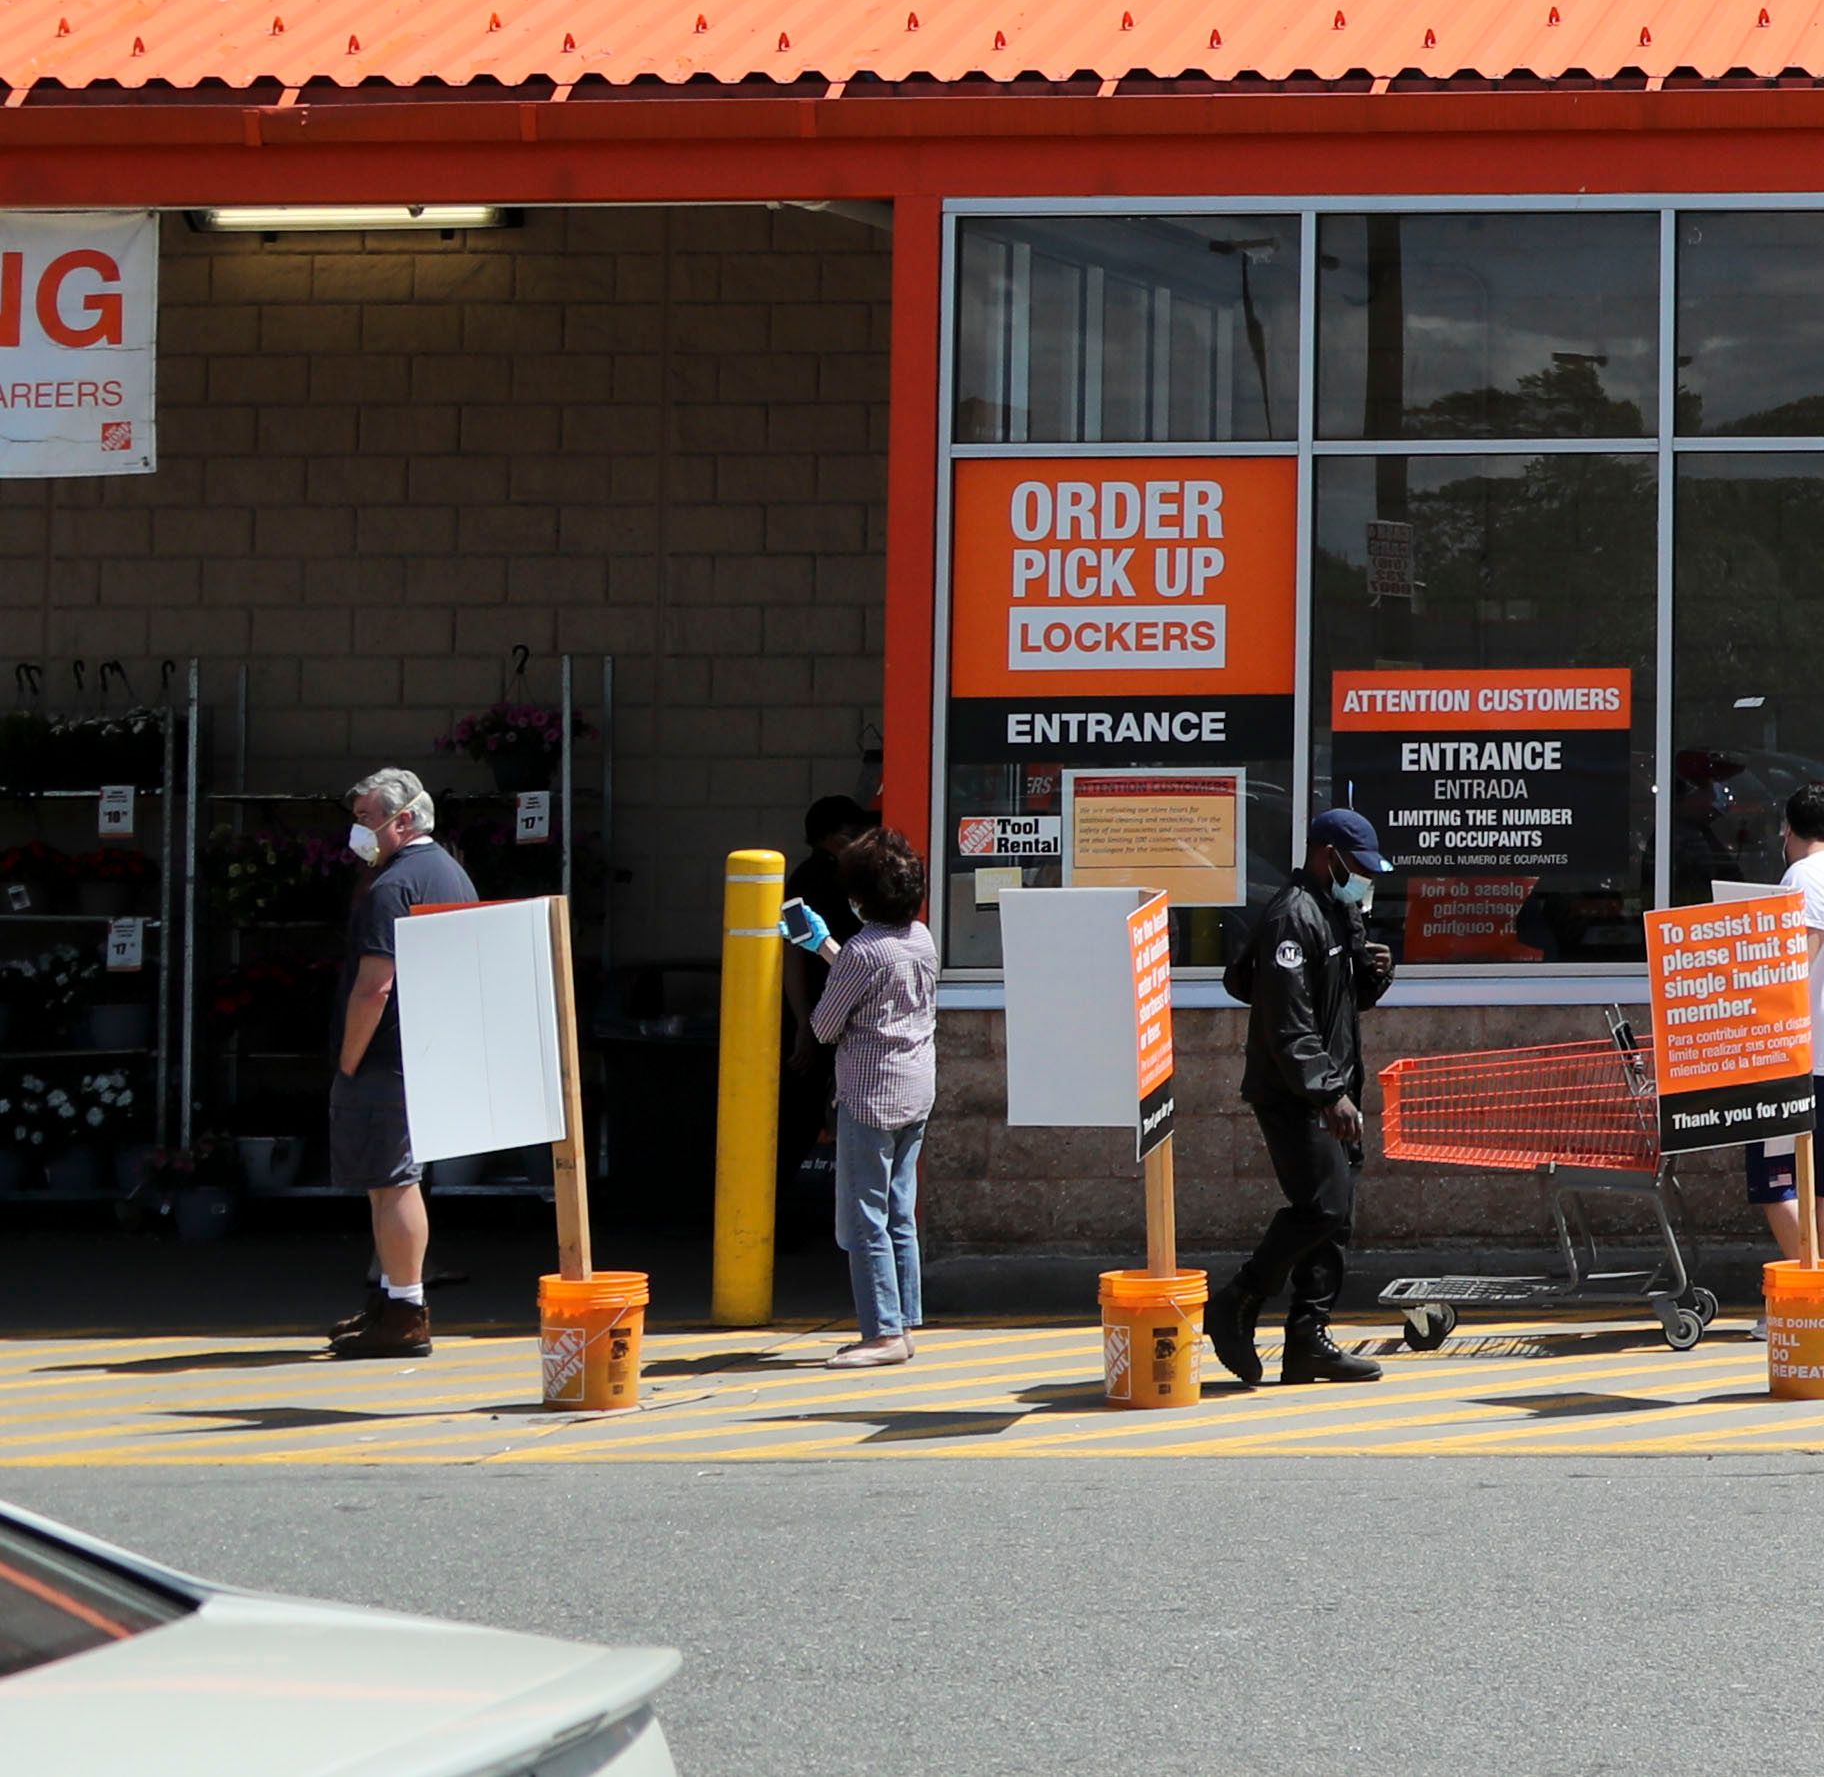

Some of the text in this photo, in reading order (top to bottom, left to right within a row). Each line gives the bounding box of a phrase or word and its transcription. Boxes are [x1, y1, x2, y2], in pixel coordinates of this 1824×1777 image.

[1011, 480, 1224, 542] ORDER
[1012, 547, 1225, 598] PICK UP
[1020, 621, 1216, 653] LOCKERS
[1343, 687, 1620, 713] ATTENTION CUSTOMERS
[1007, 711, 1226, 743] ENTRANCE
[1401, 741, 1562, 771] ENTRANCE
[1434, 779, 1528, 800] ENTRADA
[997, 818, 1039, 834] Tool
[1389, 809, 1572, 827] LIMITING THE NUMBER
[997, 837, 1058, 853] Rental
[1419, 830, 1542, 848] OF OCCUPANTS
[1444, 854, 1511, 865] EL DE
[1659, 911, 1776, 945] To assist in
[1662, 936, 1780, 976] please limit
[1664, 972, 1727, 999] single
[1666, 998, 1757, 1025] member.
[1668, 1021, 1783, 1047] Para contribuir con el
[1702, 1040, 1765, 1058] realizar sus
[1670, 1056, 1749, 1078] miembro de la
[1672, 1097, 1811, 1130] Thank you for your
[1771, 1332, 1800, 1347] FILL
[1772, 1349, 1789, 1361] DO
